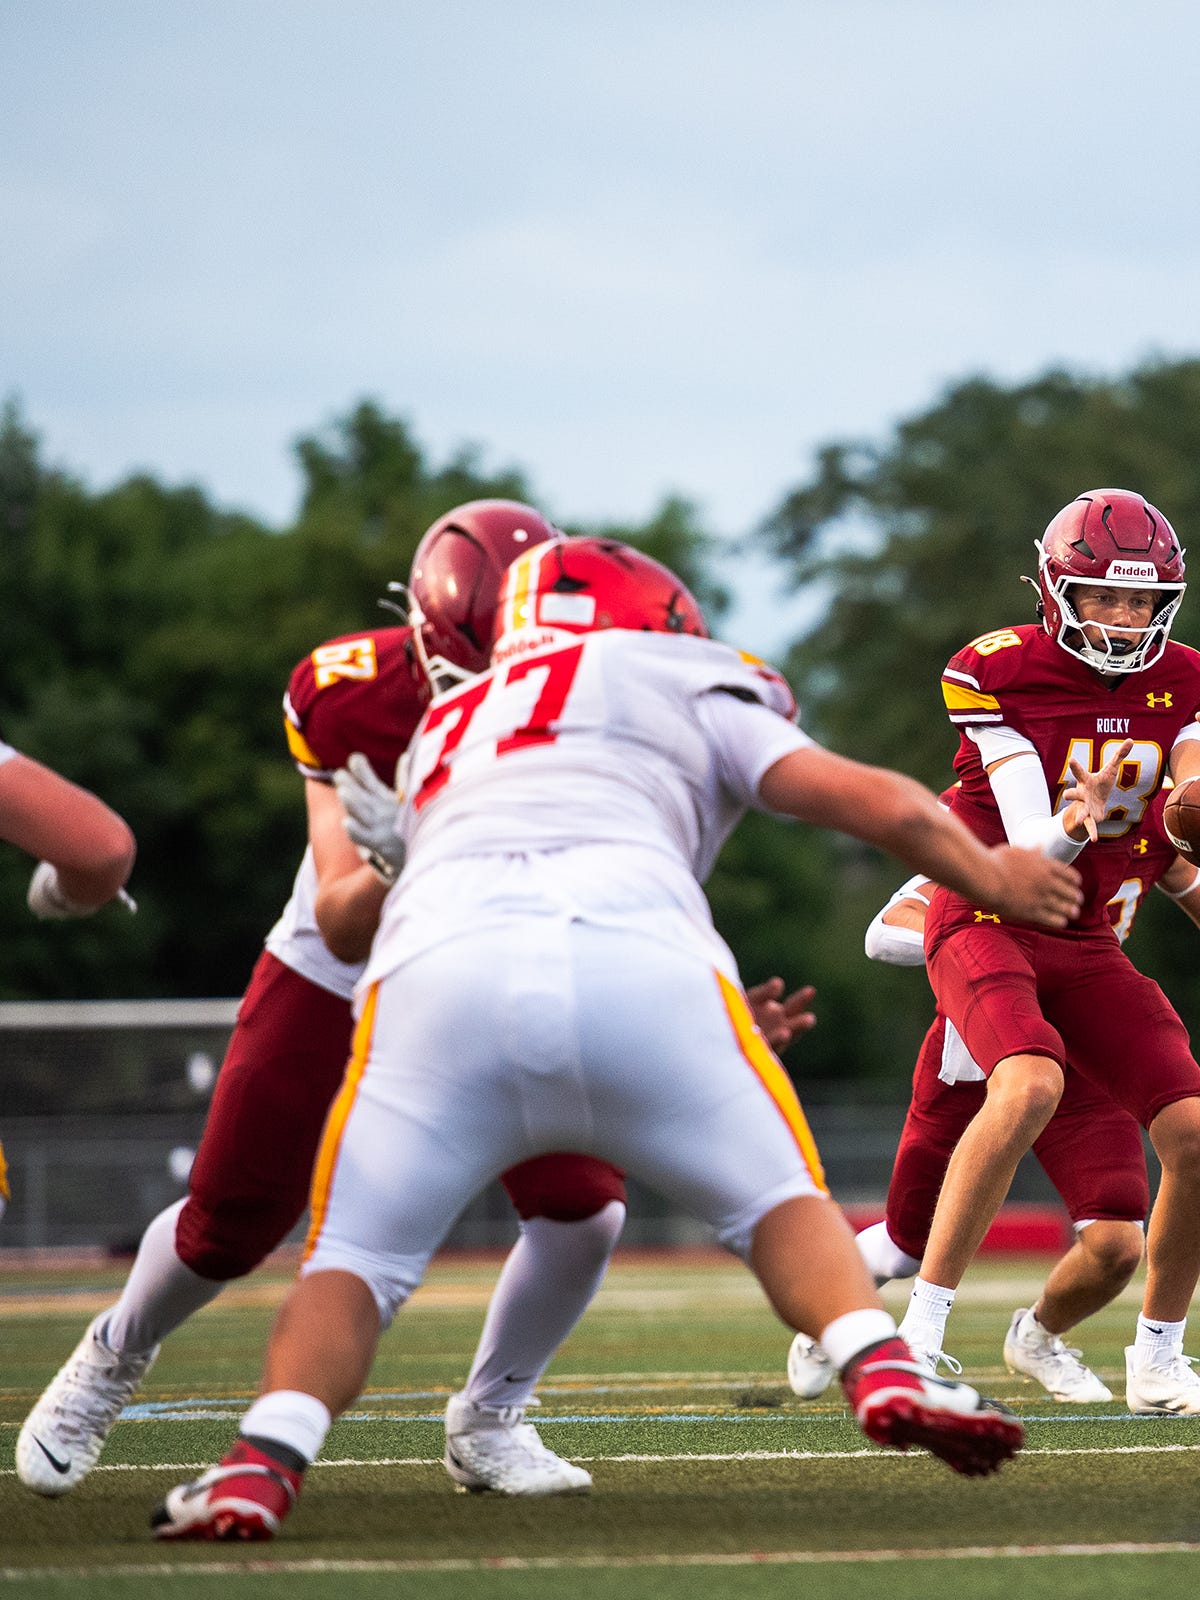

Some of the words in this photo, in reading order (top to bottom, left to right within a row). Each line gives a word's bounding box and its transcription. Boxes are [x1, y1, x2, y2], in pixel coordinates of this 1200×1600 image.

[1113, 565, 1154, 577] Riddell
[967, 628, 1023, 657] 18
[311, 637, 378, 690] 62
[412, 642, 587, 813] 77
[1096, 718, 1130, 733] ROCKY
[1051, 737, 1163, 838] 18
